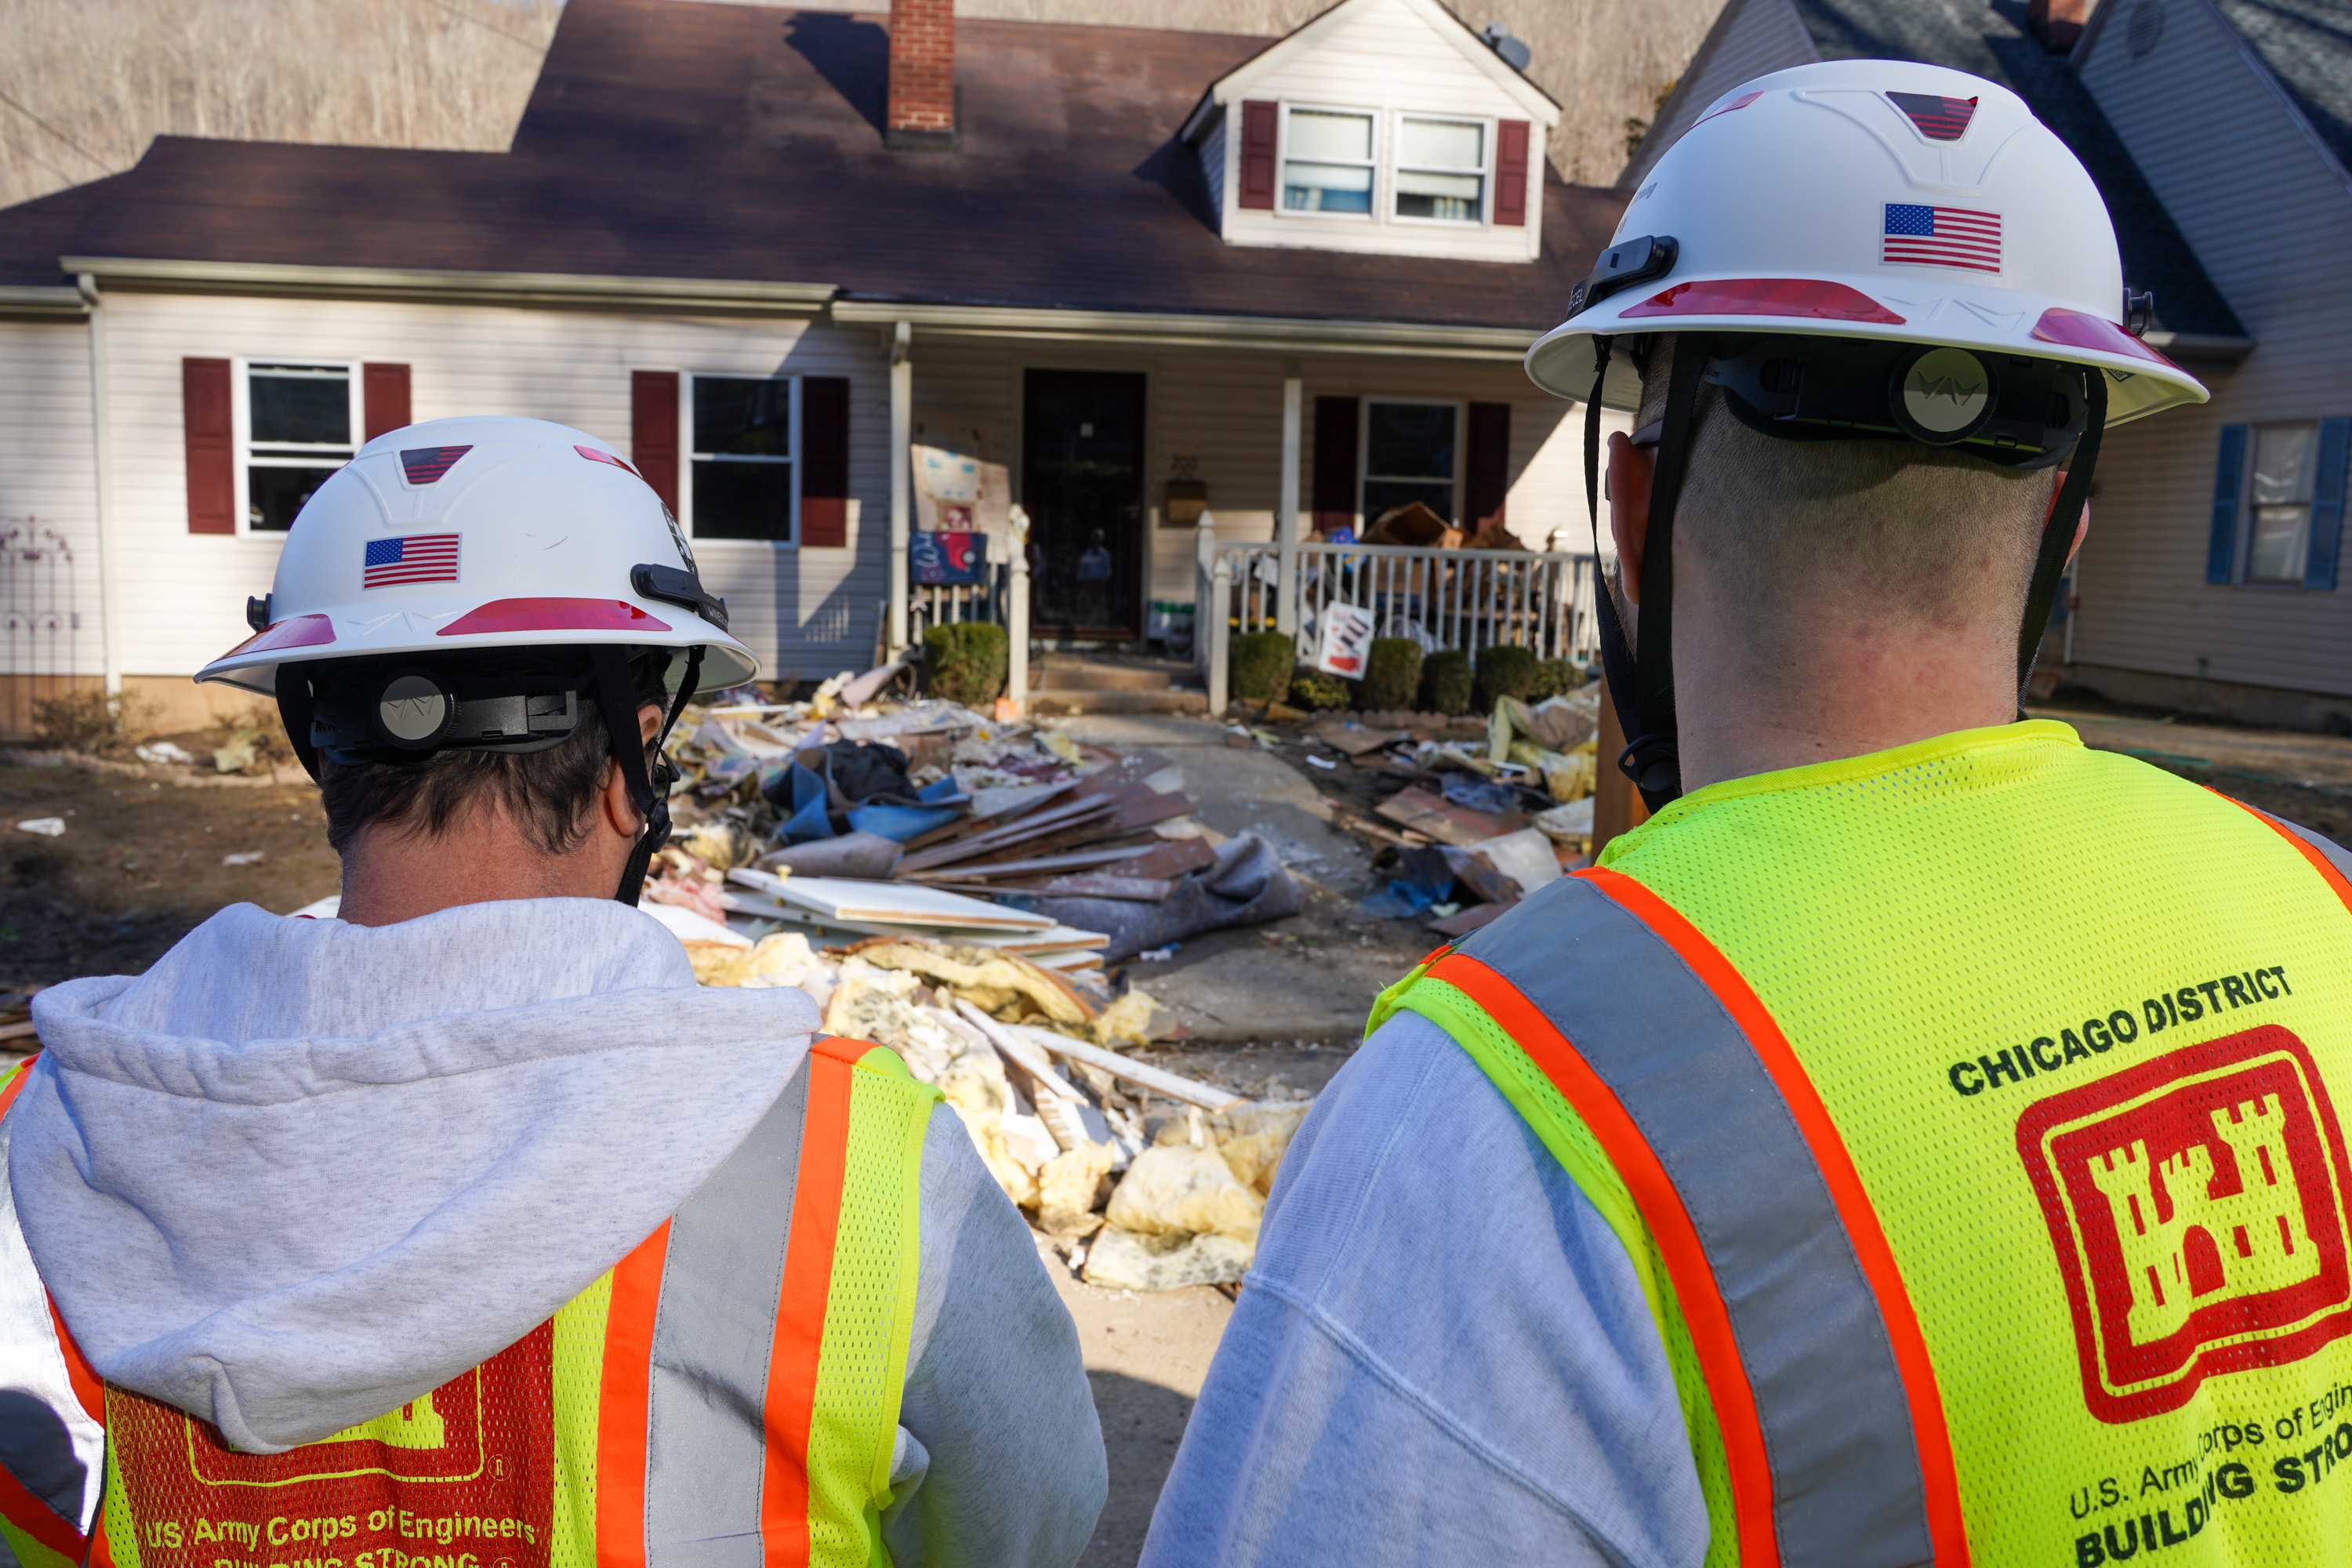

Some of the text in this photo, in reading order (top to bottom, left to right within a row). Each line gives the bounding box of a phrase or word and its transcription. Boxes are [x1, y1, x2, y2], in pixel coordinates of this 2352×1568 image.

[1948, 966, 2292, 1096] CHICAGO DISTRICT
[2070, 1381, 2352, 1519] U.S. Army Corps of Engin
[2074, 1422, 2352, 1568] BUILDING STRO
[145, 1505, 535, 1552] US Army Corps of Engineers
